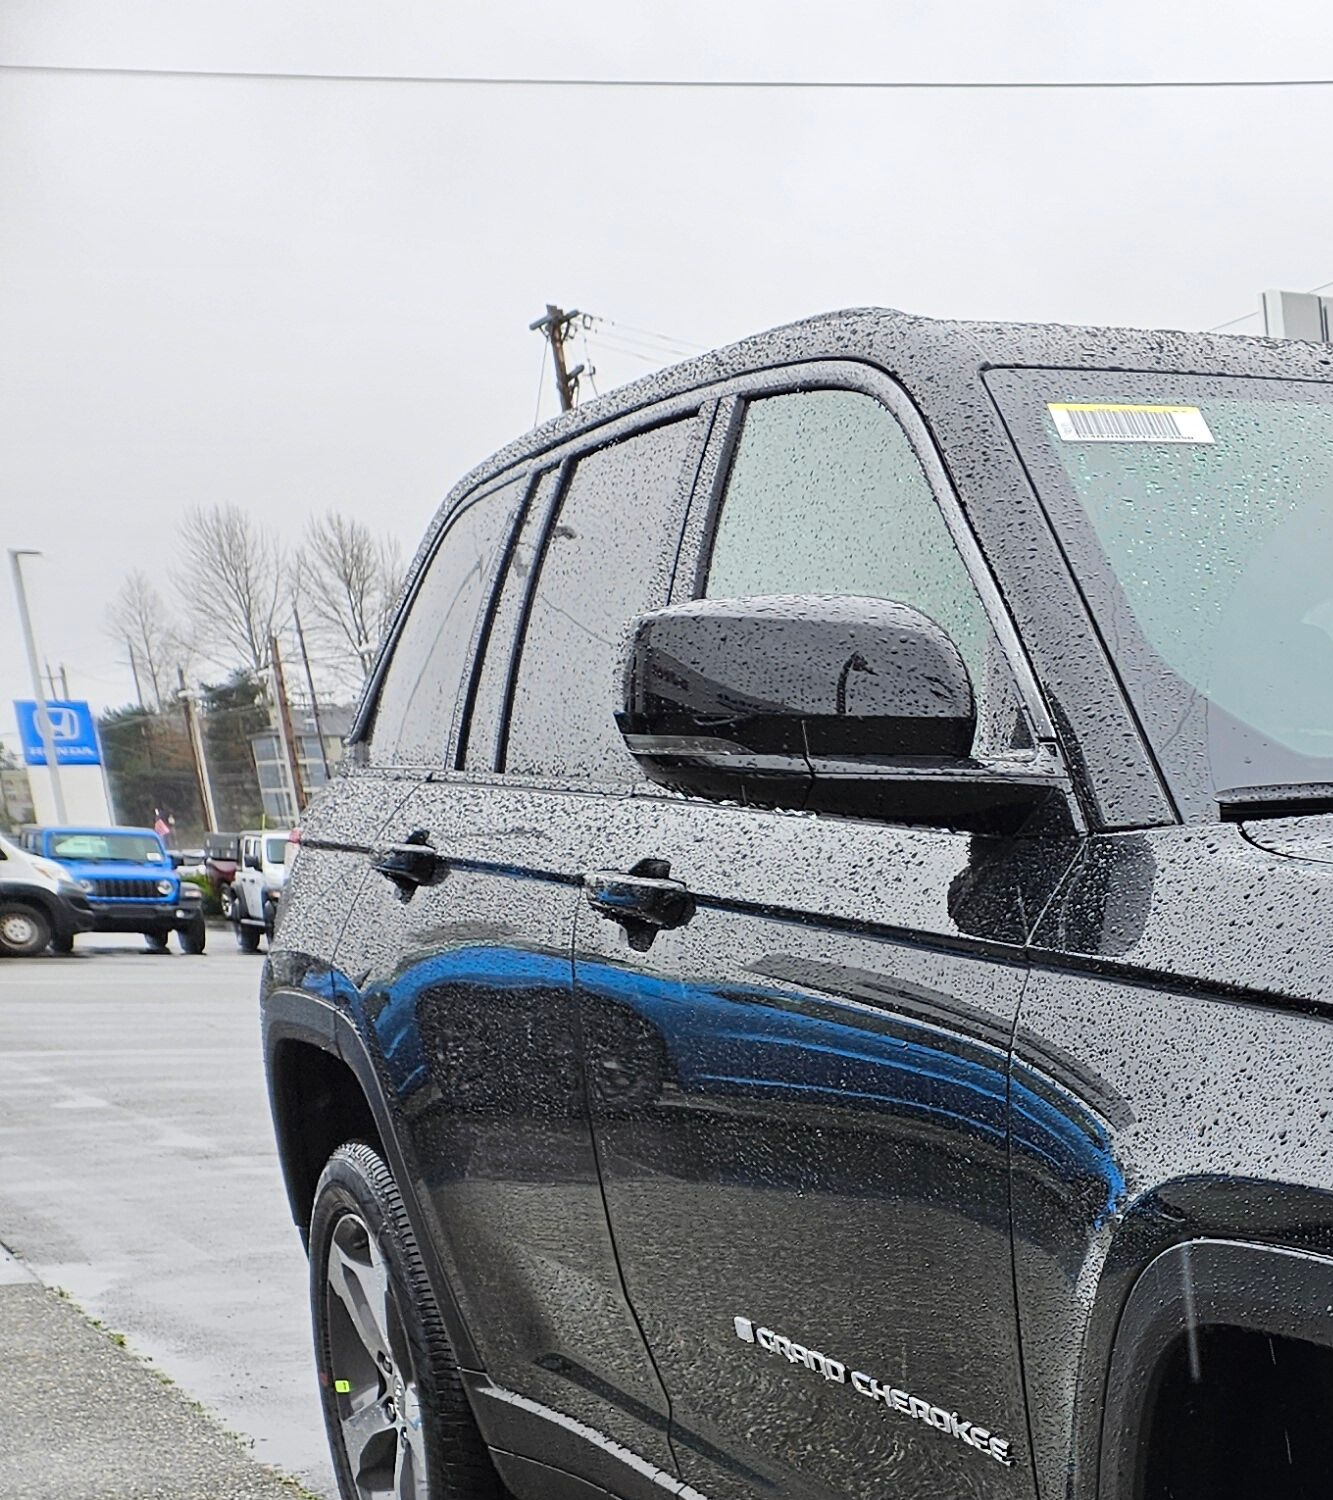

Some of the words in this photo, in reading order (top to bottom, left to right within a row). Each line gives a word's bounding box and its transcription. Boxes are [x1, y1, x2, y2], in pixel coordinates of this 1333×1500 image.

[29, 745, 96, 756] HNDA
[756, 1326, 846, 1384] GRAND
[851, 1371, 1012, 1467] CHEROKEE
